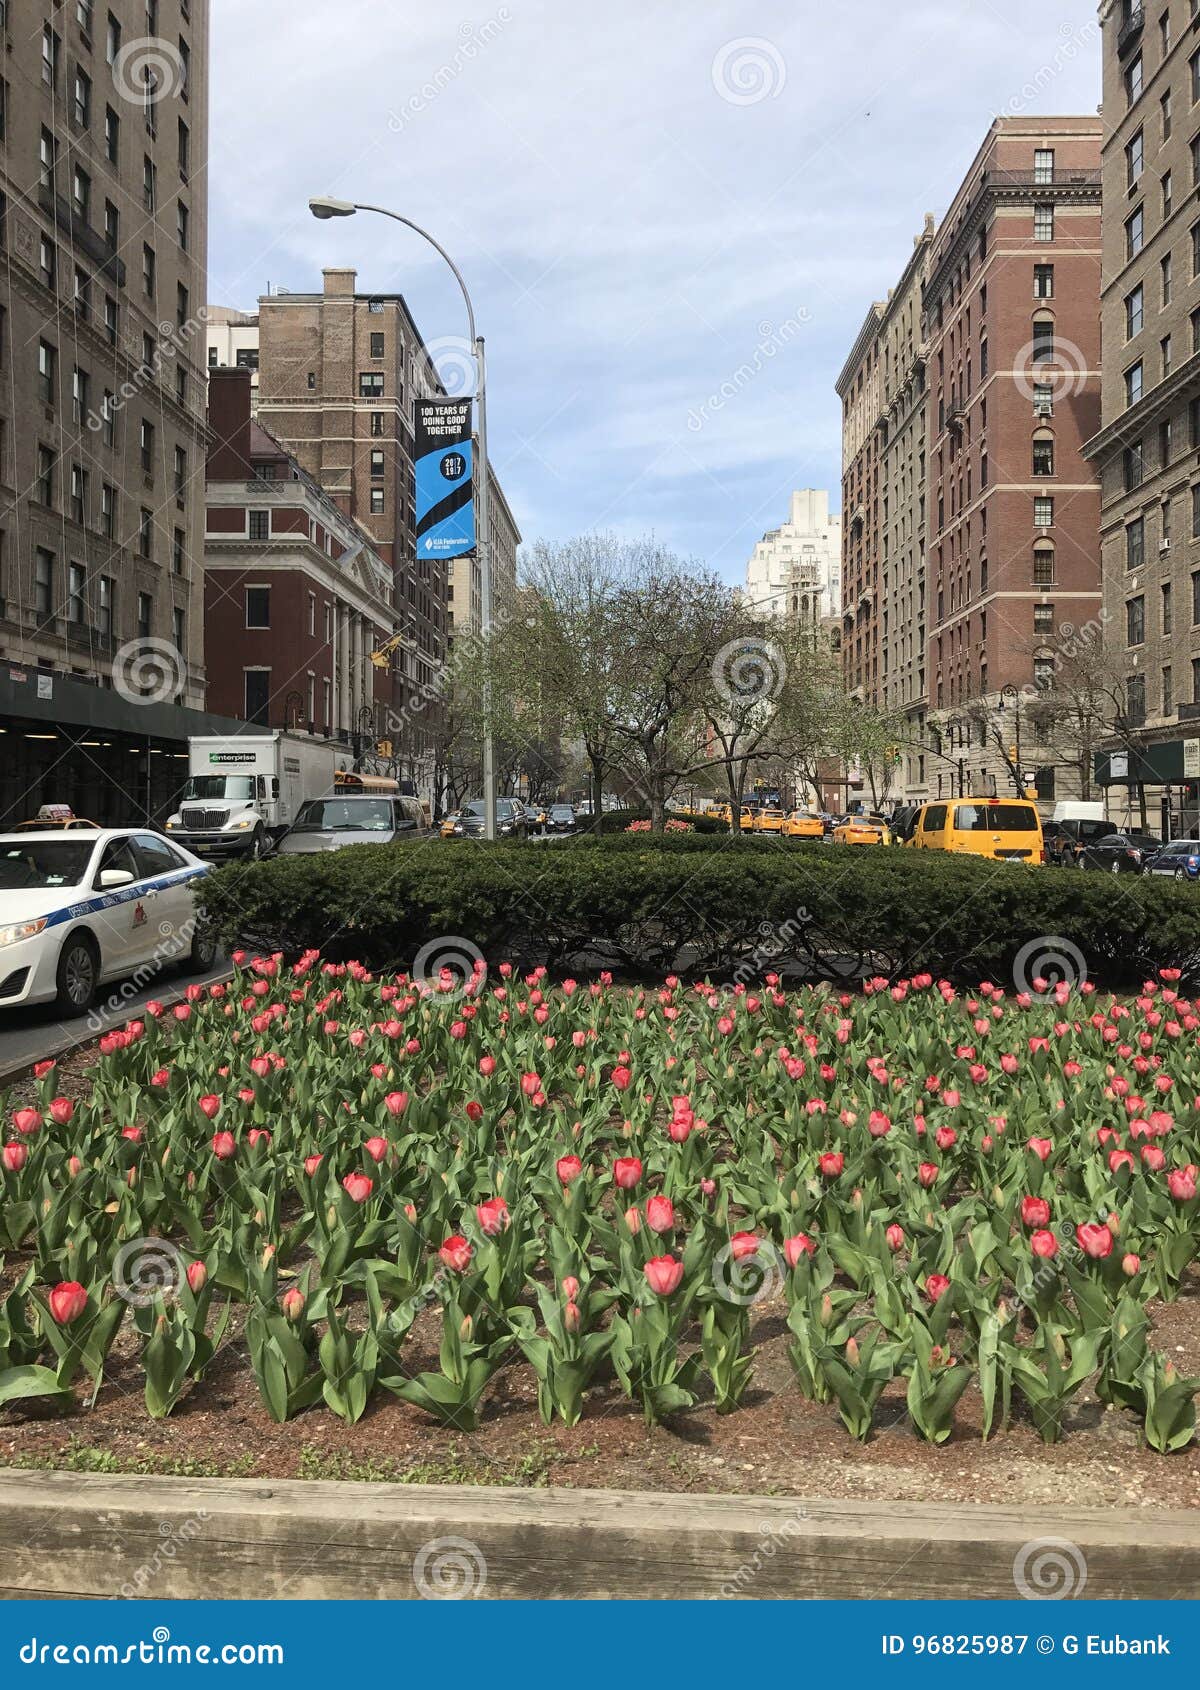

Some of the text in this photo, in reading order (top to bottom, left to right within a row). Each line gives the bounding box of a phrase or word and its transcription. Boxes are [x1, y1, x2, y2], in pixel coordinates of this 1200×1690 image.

[421, 405, 469, 417] 100 YEARS OF
[422, 415, 466, 426] DOING GOOD
[426, 425, 462, 435] TOGETHER
[210, 754, 256, 762] enterprise
